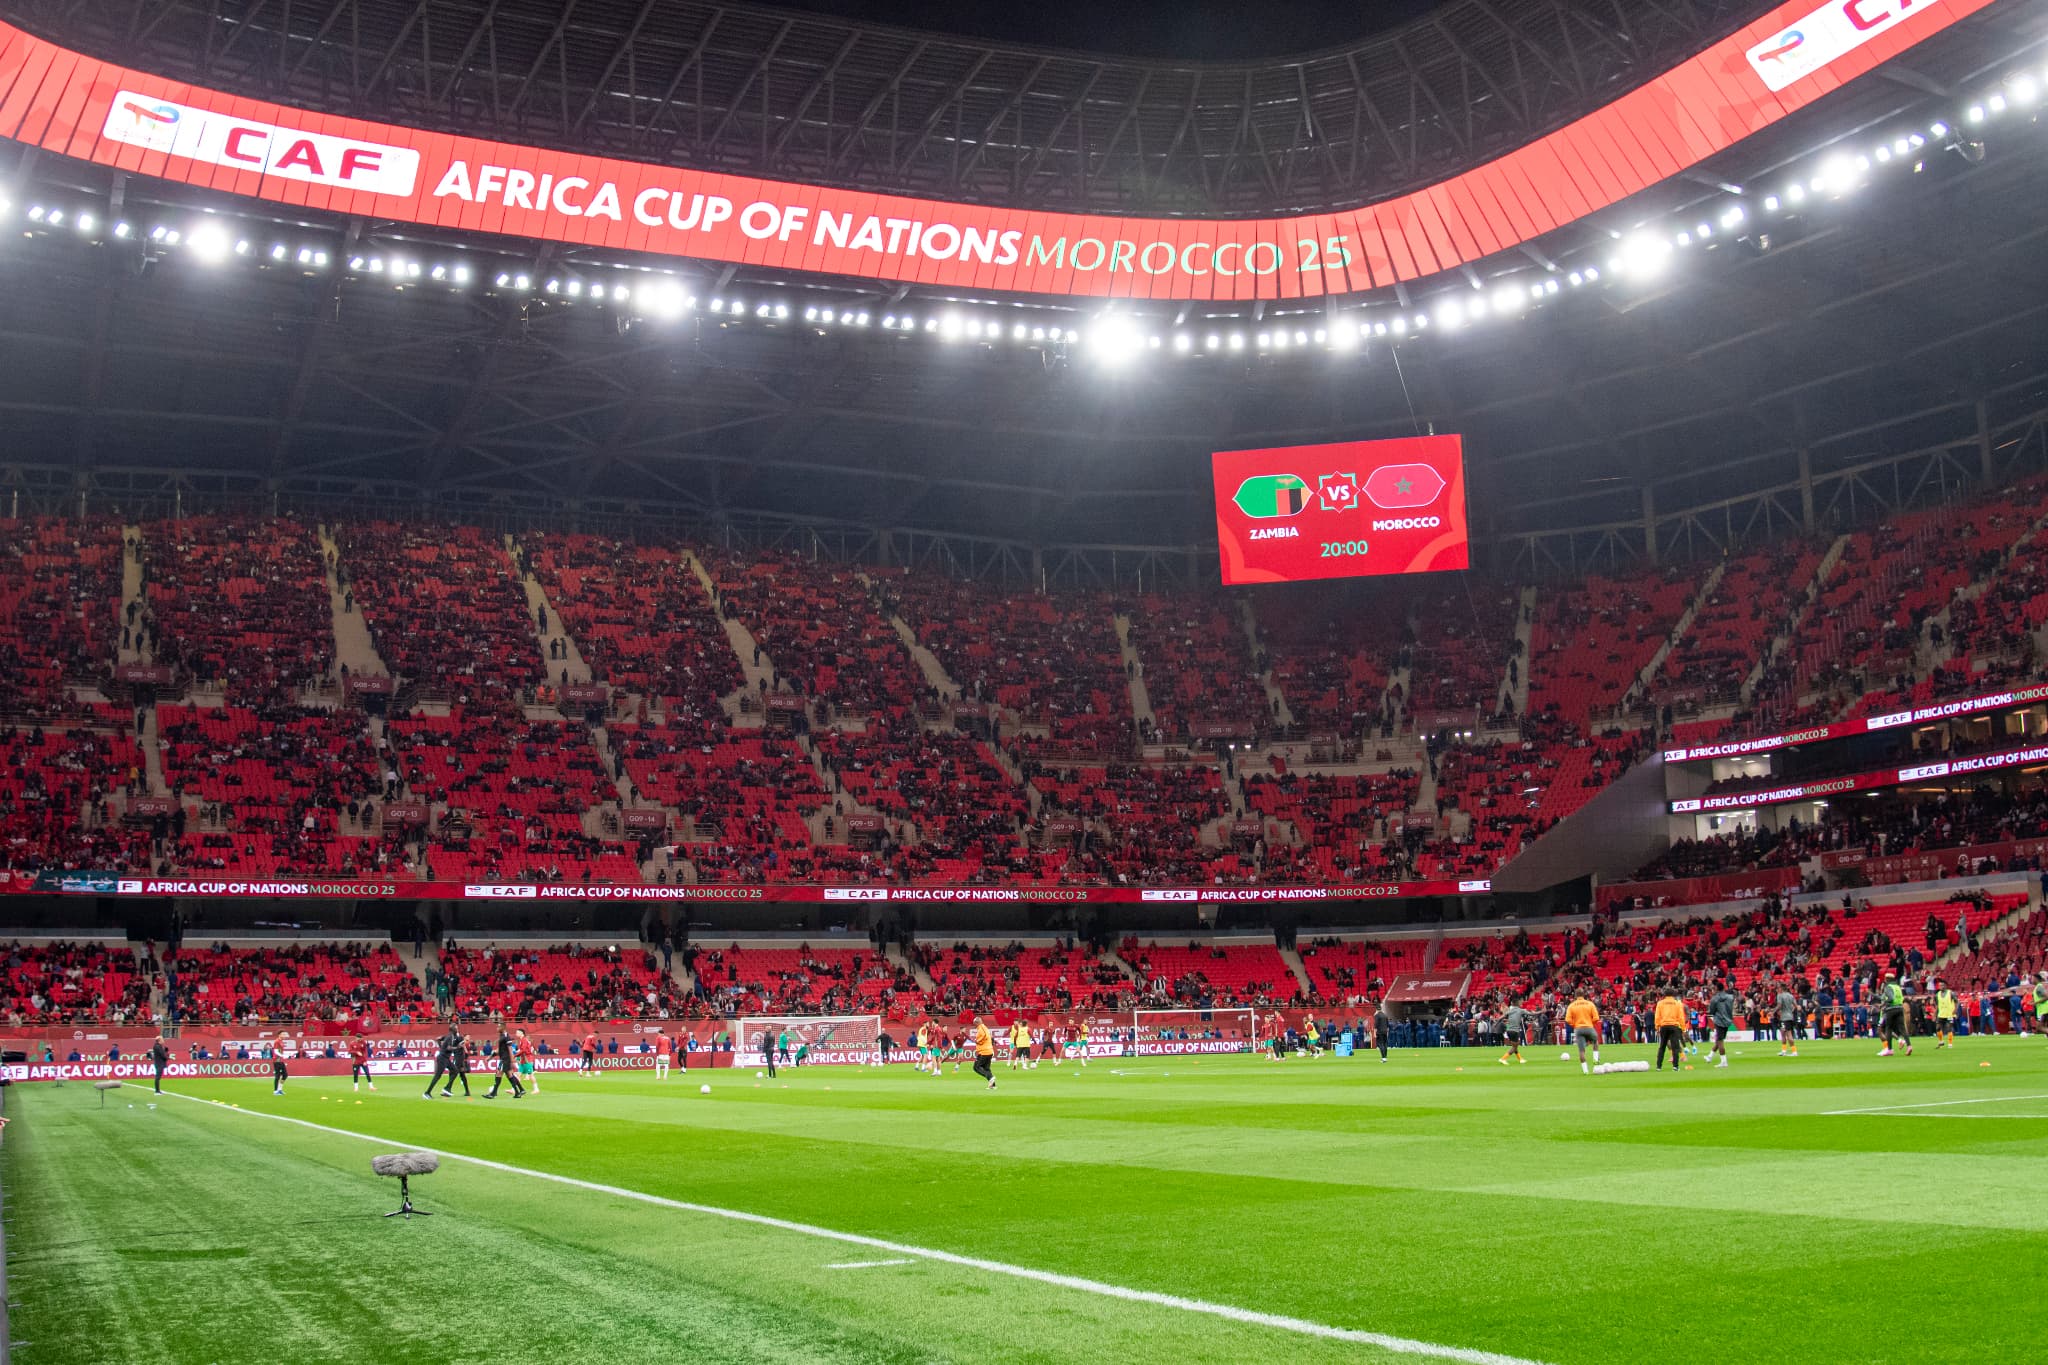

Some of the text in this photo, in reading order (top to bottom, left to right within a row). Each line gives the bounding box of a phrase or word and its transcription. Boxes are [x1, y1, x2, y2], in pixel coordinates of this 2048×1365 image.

[224, 126, 383, 181] CAF
[433, 160, 1353, 276] AFRICA CUP OF NATIONS MOROCCO 25
[1327, 485, 1350, 501] VS
[1372, 516, 1440, 531] MOROCCO
[1249, 526, 1299, 540] ZAMBIA
[1320, 540, 1369, 557] 20:00
[1884, 714, 1907, 725] CAF
[1914, 706, 1943, 720] AFRICA
[1944, 704, 1961, 715] CUP
[1961, 701, 1974, 711] OF
[1974, 693, 2012, 709] NATIONS
[1665, 728, 1829, 760] AF AFRICA CUP OF NATIONS MOROCCO 25
[1917, 766, 1944, 777] CAF
[1952, 758, 1985, 772] AFRICA
[1985, 755, 2004, 767] CUP
[2006, 752, 2019, 763] OF
[1676, 780, 1854, 810] AF AFRICA CUP OF NATIONS MOROCCO 25
[147, 882, 197, 893] AFRICA
[200, 883, 226, 893] CUP
[228, 883, 248, 893] OF
[250, 883, 308, 894] NATIONS
[310, 885, 378, 895] MOROCCO
[381, 885, 395, 895] 25
[492, 887, 762, 898] CAF AFRICA CUP OF NATIONS MOROCCO 25
[848, 890, 1087, 900] CAF AFRICA CUP OF NATIONS MOROCCO 25
[1162, 886, 1399, 900] CAF AFRICA CUP OF NATIONS MOROCCO 25
[1164, 1043, 1185, 1053] CUP
[1186, 1042, 1199, 1053] OF
[1201, 1041, 1243, 1052] NATIONS
[805, 1052, 847, 1063] AFRICA
[31, 1065, 82, 1078] AFRICA
[84, 1064, 112, 1077] CUP
[114, 1064, 135, 1076] OF
[136, 1063, 197, 1076] NAIONS
[199, 1063, 271, 1075] MOROCCO
[389, 1061, 427, 1071] CAF
